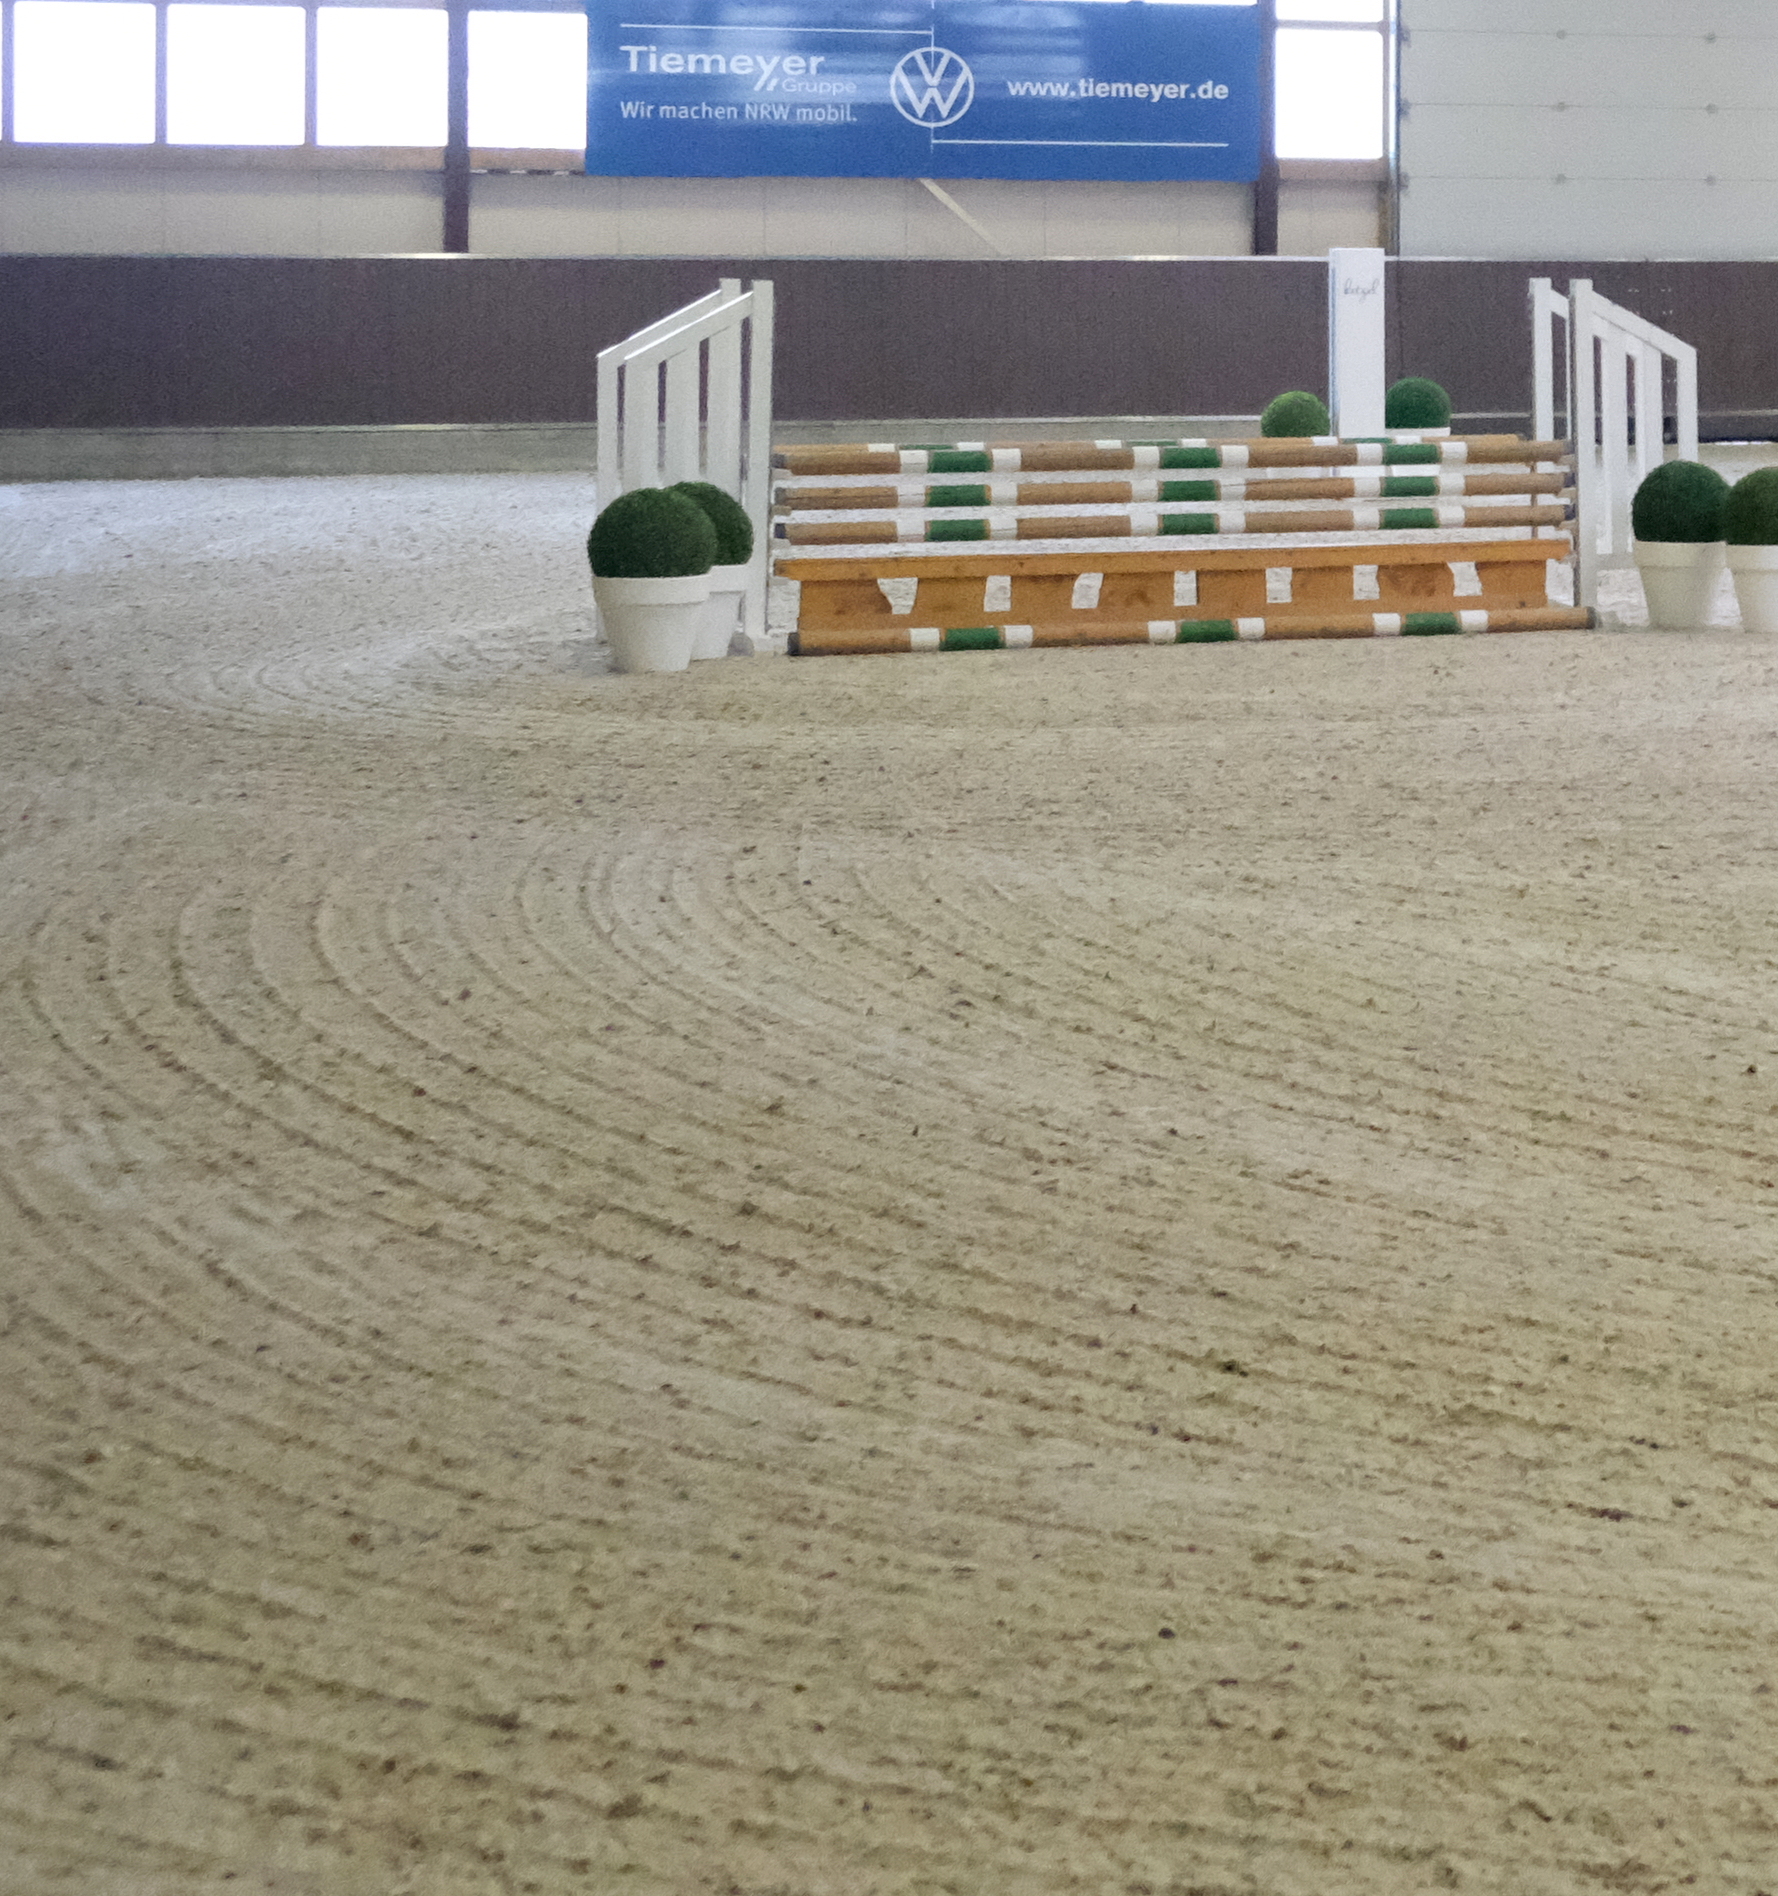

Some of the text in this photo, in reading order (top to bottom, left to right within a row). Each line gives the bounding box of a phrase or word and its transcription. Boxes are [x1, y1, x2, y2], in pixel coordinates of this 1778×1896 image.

[619, 45, 825, 91] Tiemeyer
[782, 77, 857, 96] Gruppe
[1008, 78, 1229, 103] www.tiemeyer.de
[620, 101, 858, 122] Wir machen NRW mobil.
